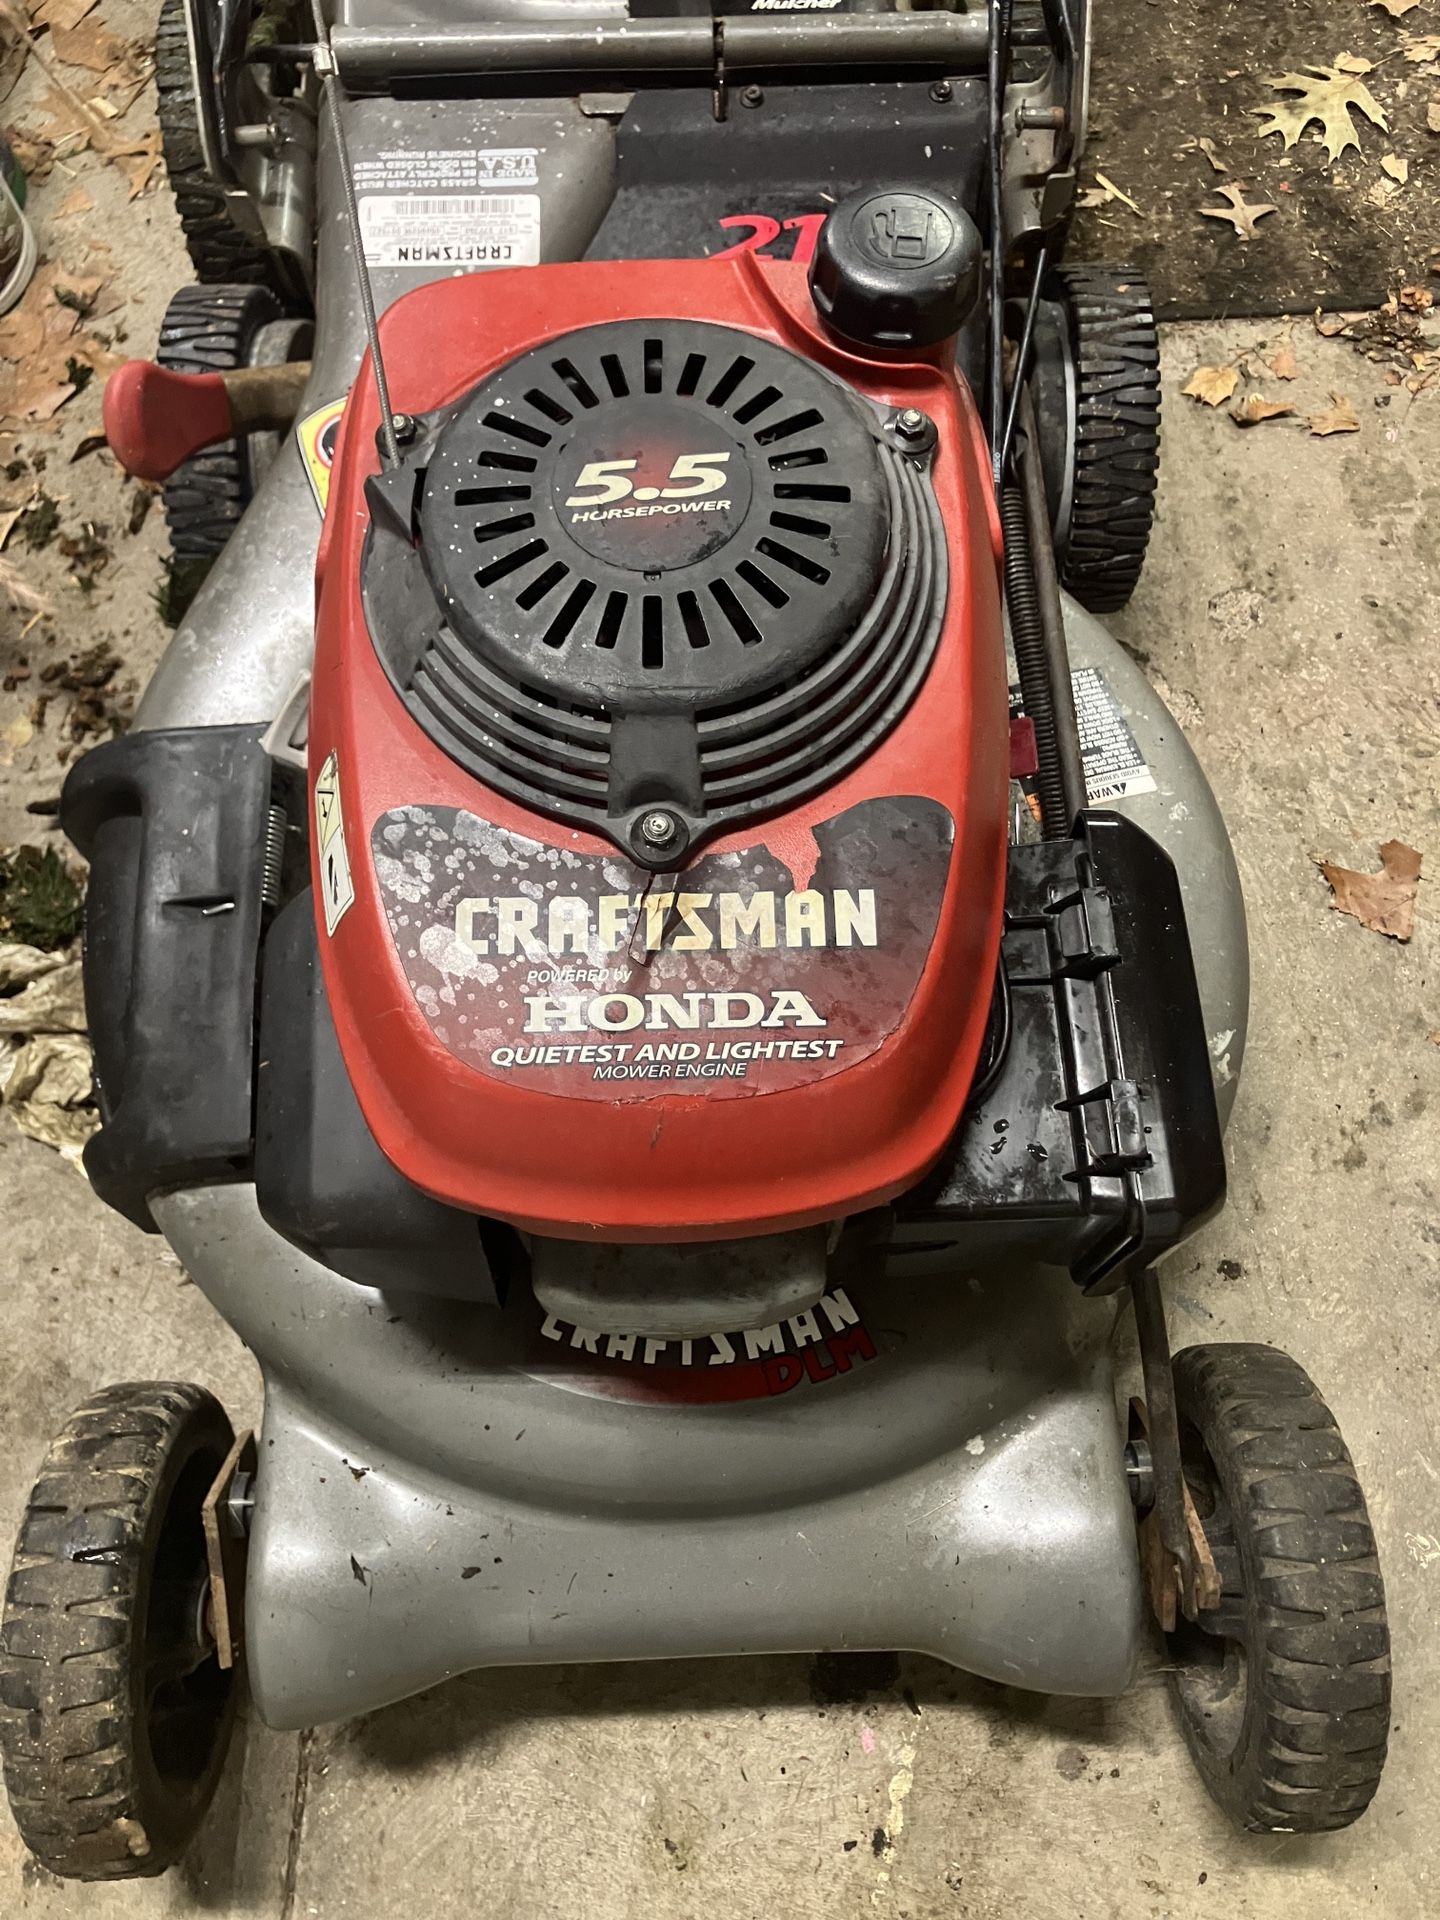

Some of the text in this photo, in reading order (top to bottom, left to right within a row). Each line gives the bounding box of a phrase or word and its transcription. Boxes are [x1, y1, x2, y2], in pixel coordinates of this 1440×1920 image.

[408, 169, 460, 178] PROPERLY
[440, 179, 477, 188] GRASS
[479, 168, 536, 178] MADE IN
[387, 180, 438, 188] CATCHER
[709, 214, 828, 263] 21
[398, 246, 512, 261] CRAFTSMAN
[565, 452, 730, 506] 5.5
[572, 500, 732, 523] HORSEPOWER
[454, 888, 878, 956] CRAFTSMAN
[526, 968, 632, 984] POWERED by
[523, 990, 827, 1034] HONDA
[491, 1039, 844, 1068] QUIETEST AND LIGHTEST
[593, 1060, 746, 1080] MOWER ENGINE
[761, 1326, 878, 1396] DLM
